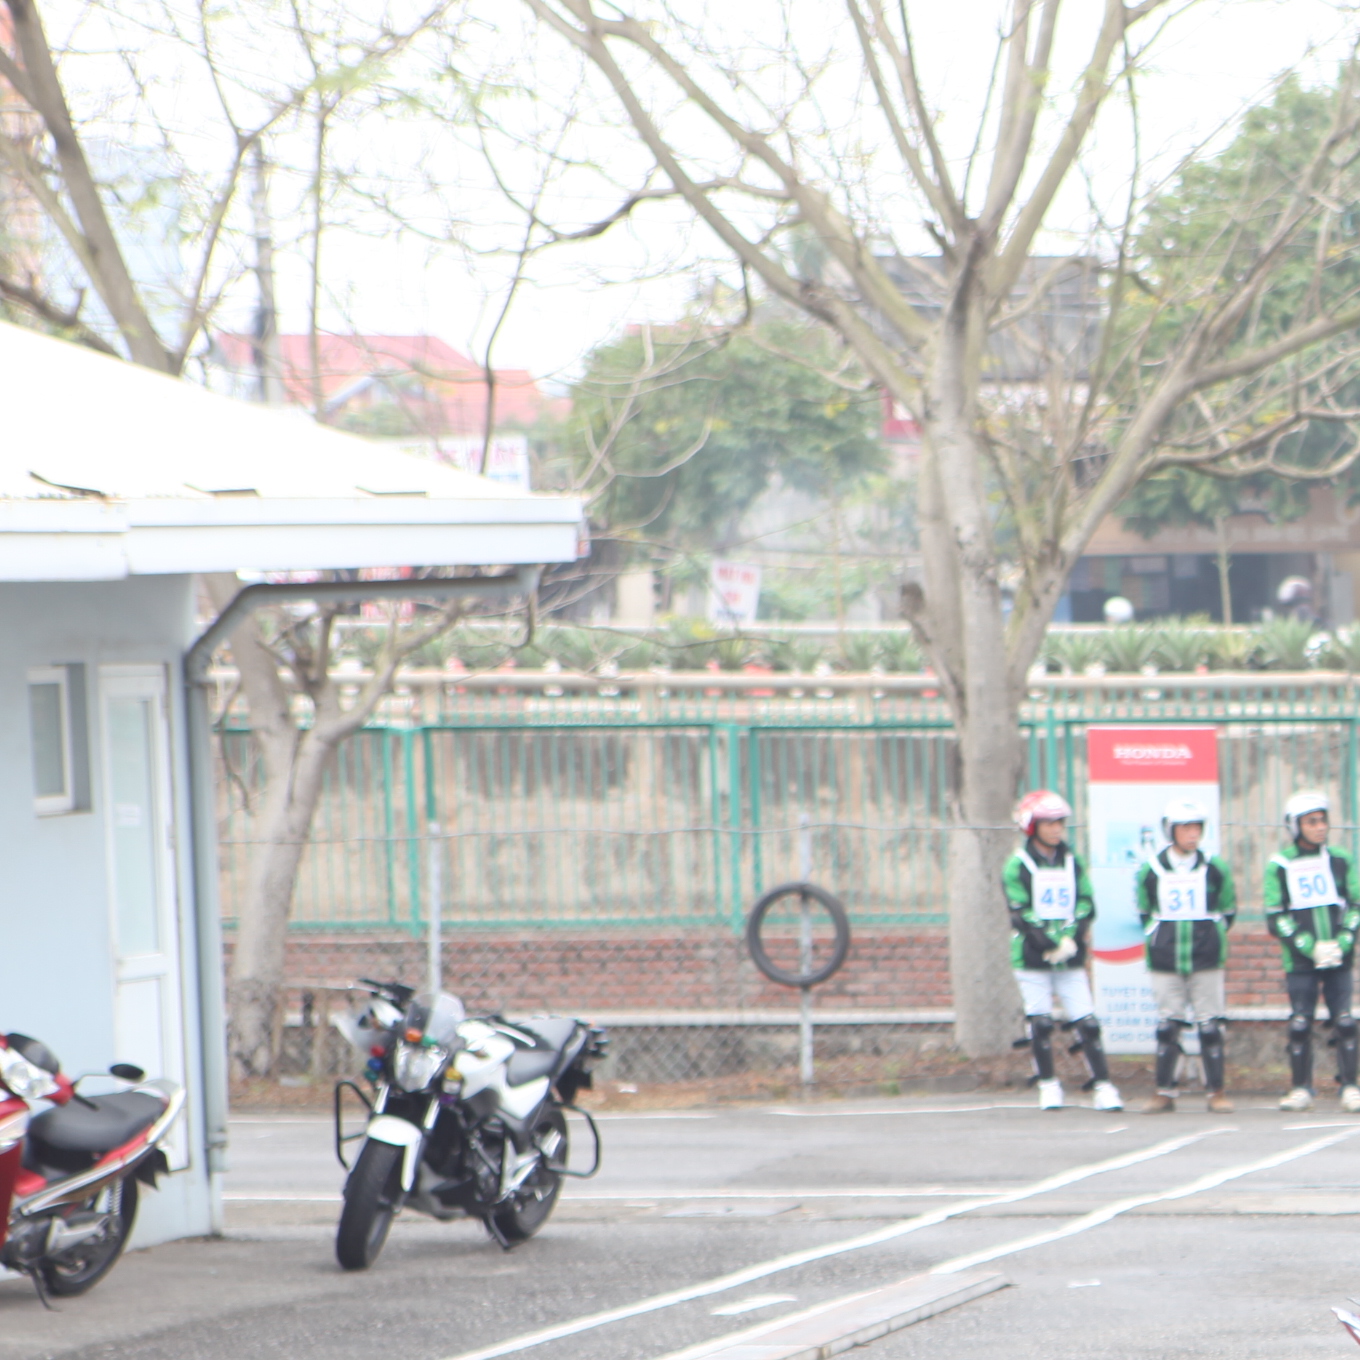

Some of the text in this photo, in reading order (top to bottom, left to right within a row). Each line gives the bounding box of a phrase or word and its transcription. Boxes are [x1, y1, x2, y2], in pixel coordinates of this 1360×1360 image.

[1113, 744, 1193, 759] HONDA
[1298, 874, 1328, 898] 50
[1040, 888, 1070, 908] 45
[1168, 889, 1196, 911] 31
